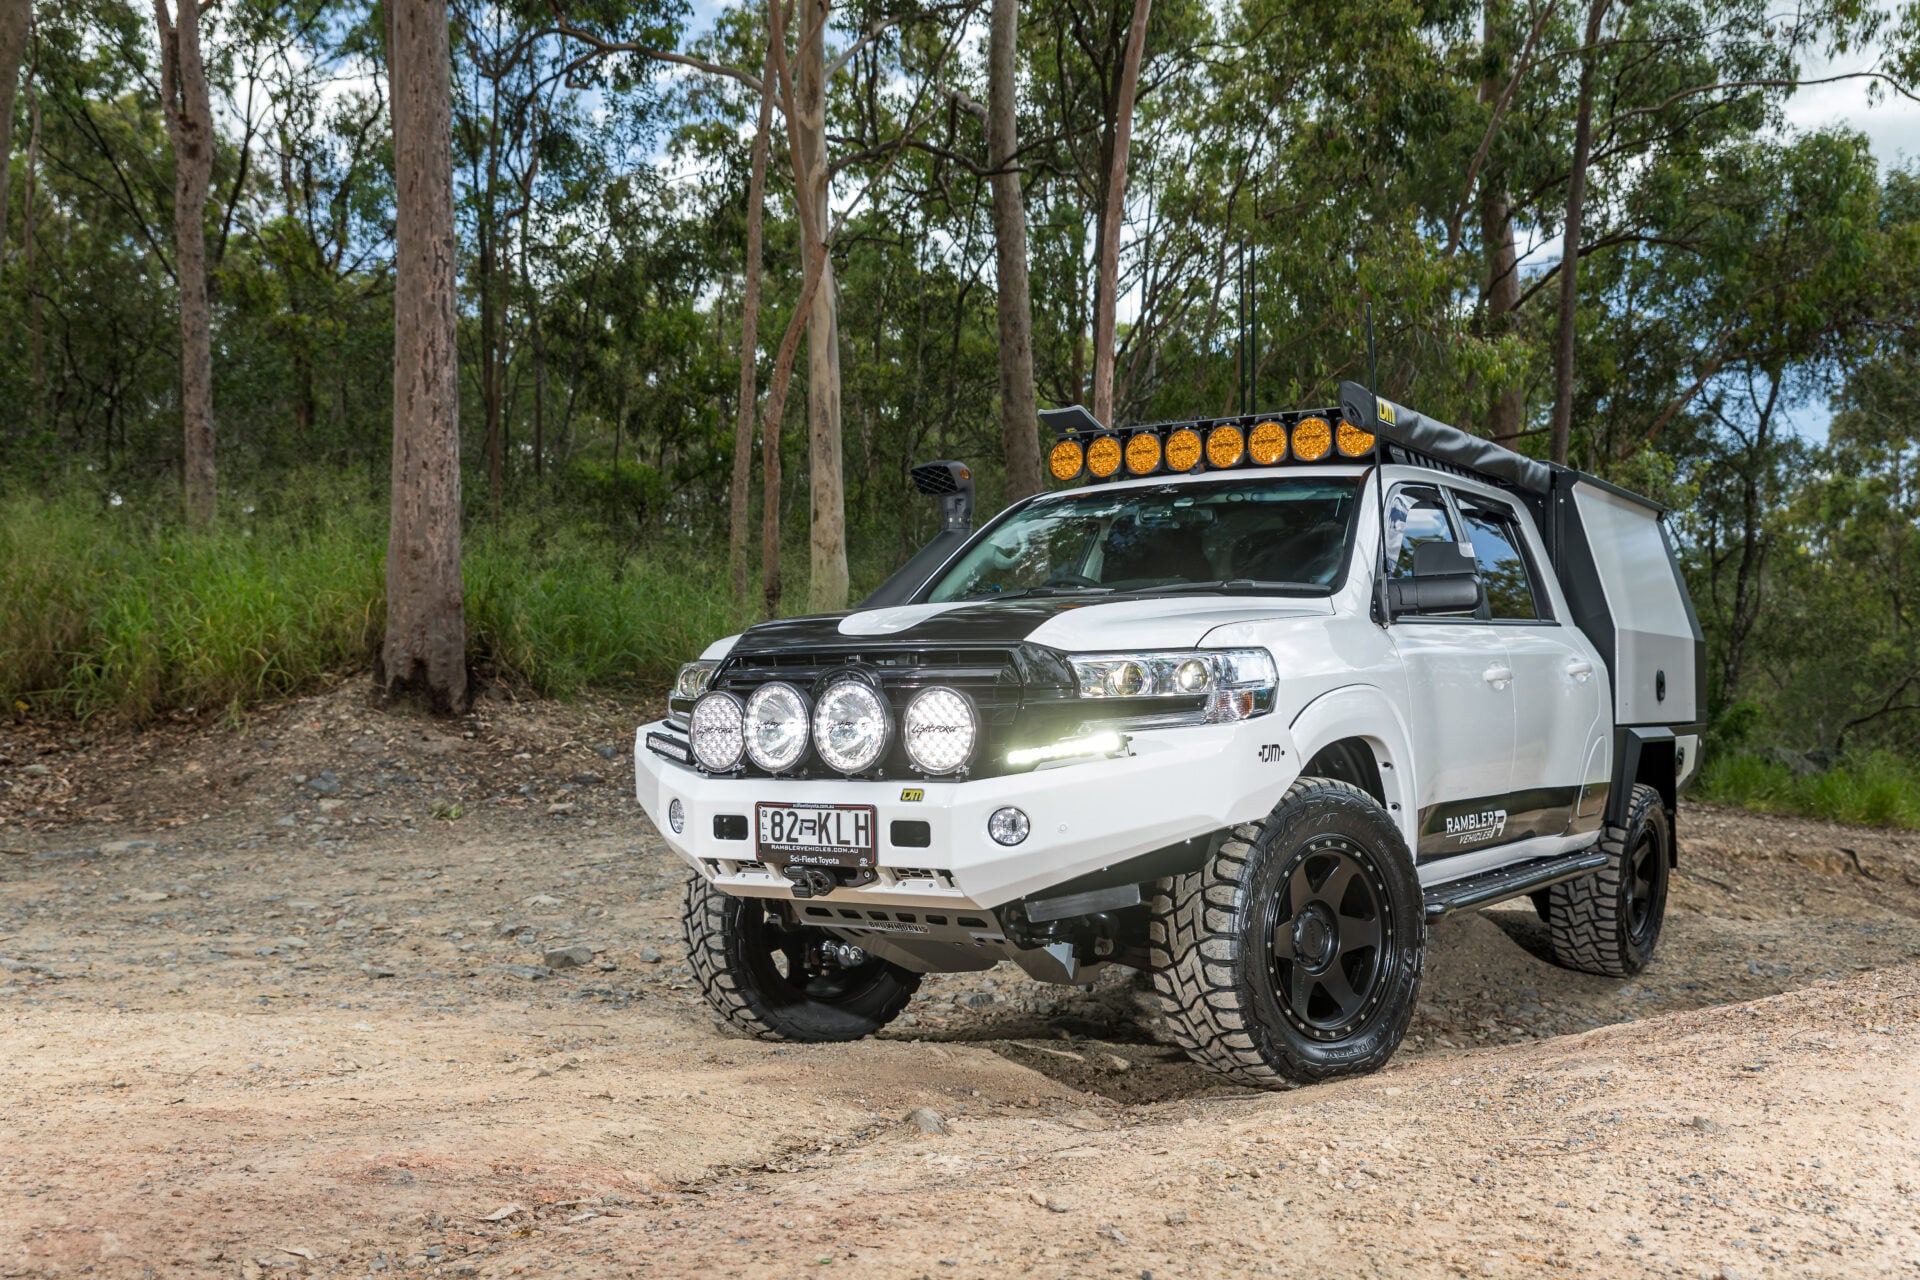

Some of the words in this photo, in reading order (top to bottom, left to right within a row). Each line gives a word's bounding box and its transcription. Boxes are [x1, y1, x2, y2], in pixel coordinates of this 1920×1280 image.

[1446, 811, 1494, 833] RAMBLER
[1459, 830, 1492, 844] VEHICLES
[771, 844, 858, 854] RAMBLERVEHICLES.COM.AU
[790, 855, 817, 864] Sci-Fleet
[818, 855, 840, 865] Toyota
